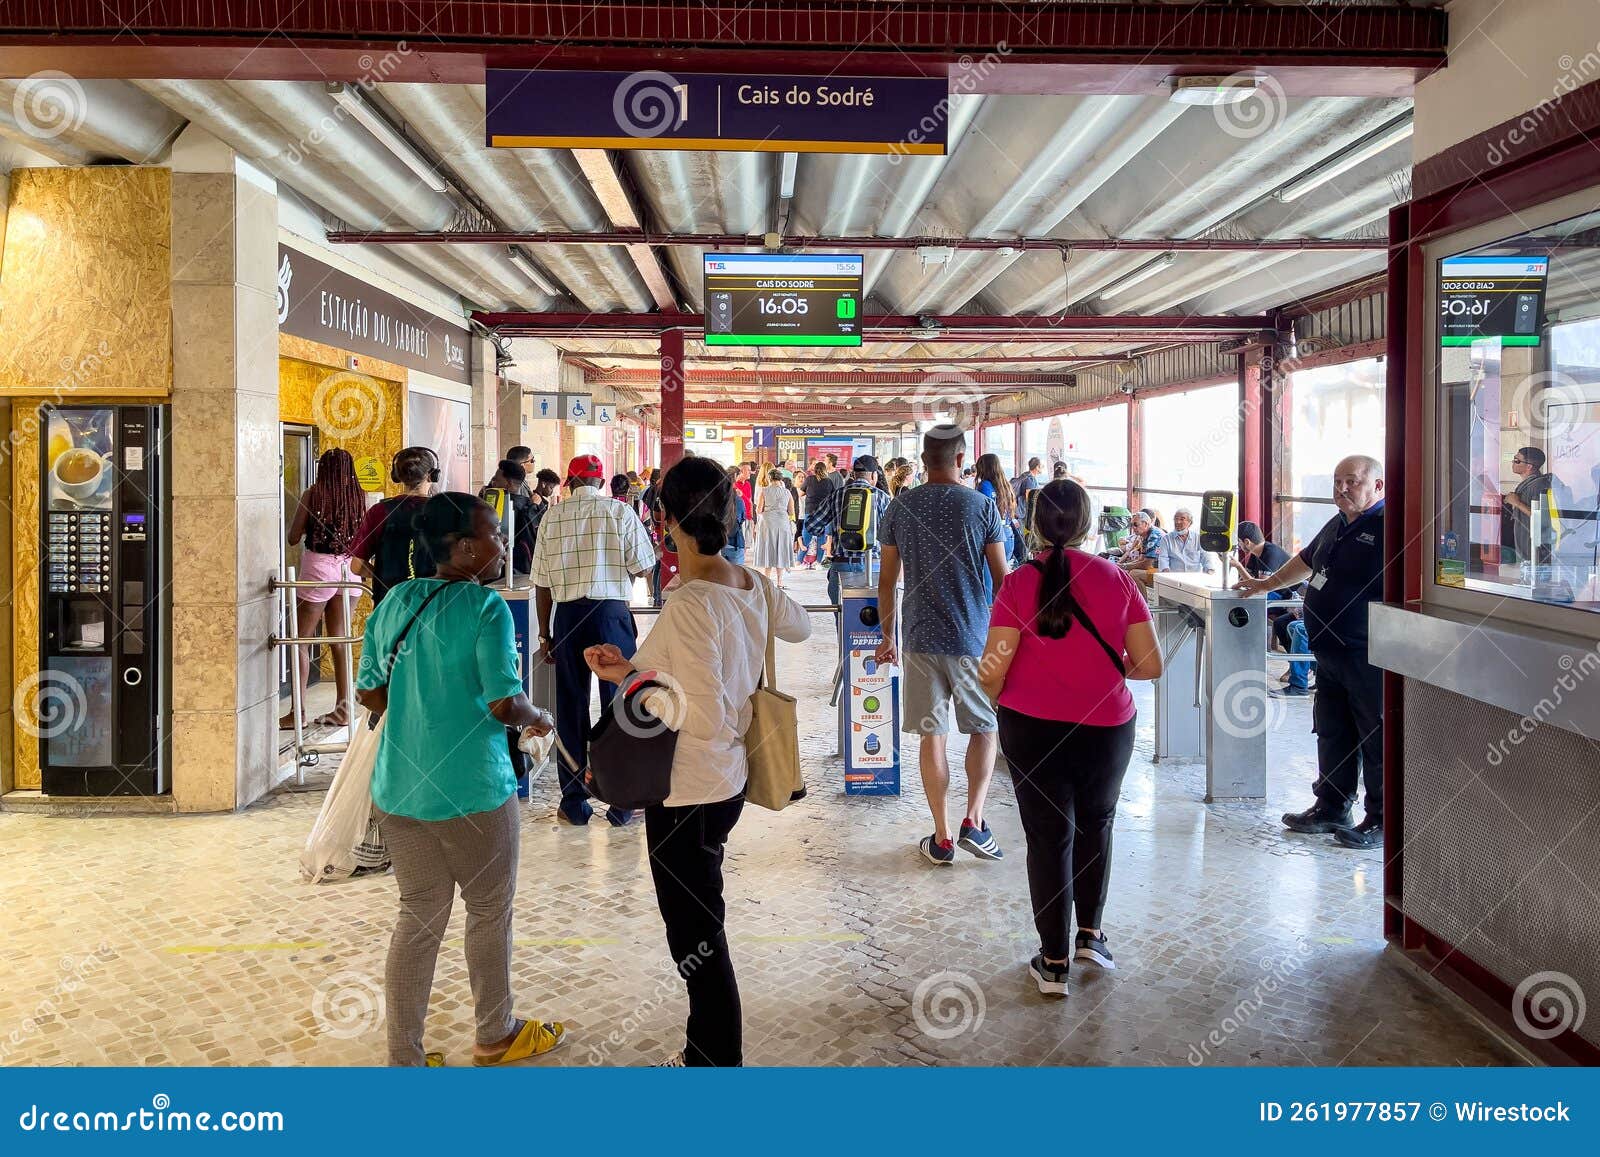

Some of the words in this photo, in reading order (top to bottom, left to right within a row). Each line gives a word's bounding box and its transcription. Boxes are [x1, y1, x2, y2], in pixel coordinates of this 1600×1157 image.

[672, 83, 689, 121] 1
[738, 84, 780, 105] Cais
[785, 85, 811, 105] do
[816, 86, 874, 106] Sodré
[836, 263, 856, 271] 15:56
[756, 280, 775, 288] CAIS
[775, 280, 788, 288] DO
[788, 279, 815, 288] SODRÉ
[758, 298, 809, 315] 16:05
[321, 290, 368, 340] ESTAÇÃO
[374, 311, 391, 346] DOS
[395, 319, 429, 359] SABORES
[755, 429, 763, 445] 1
